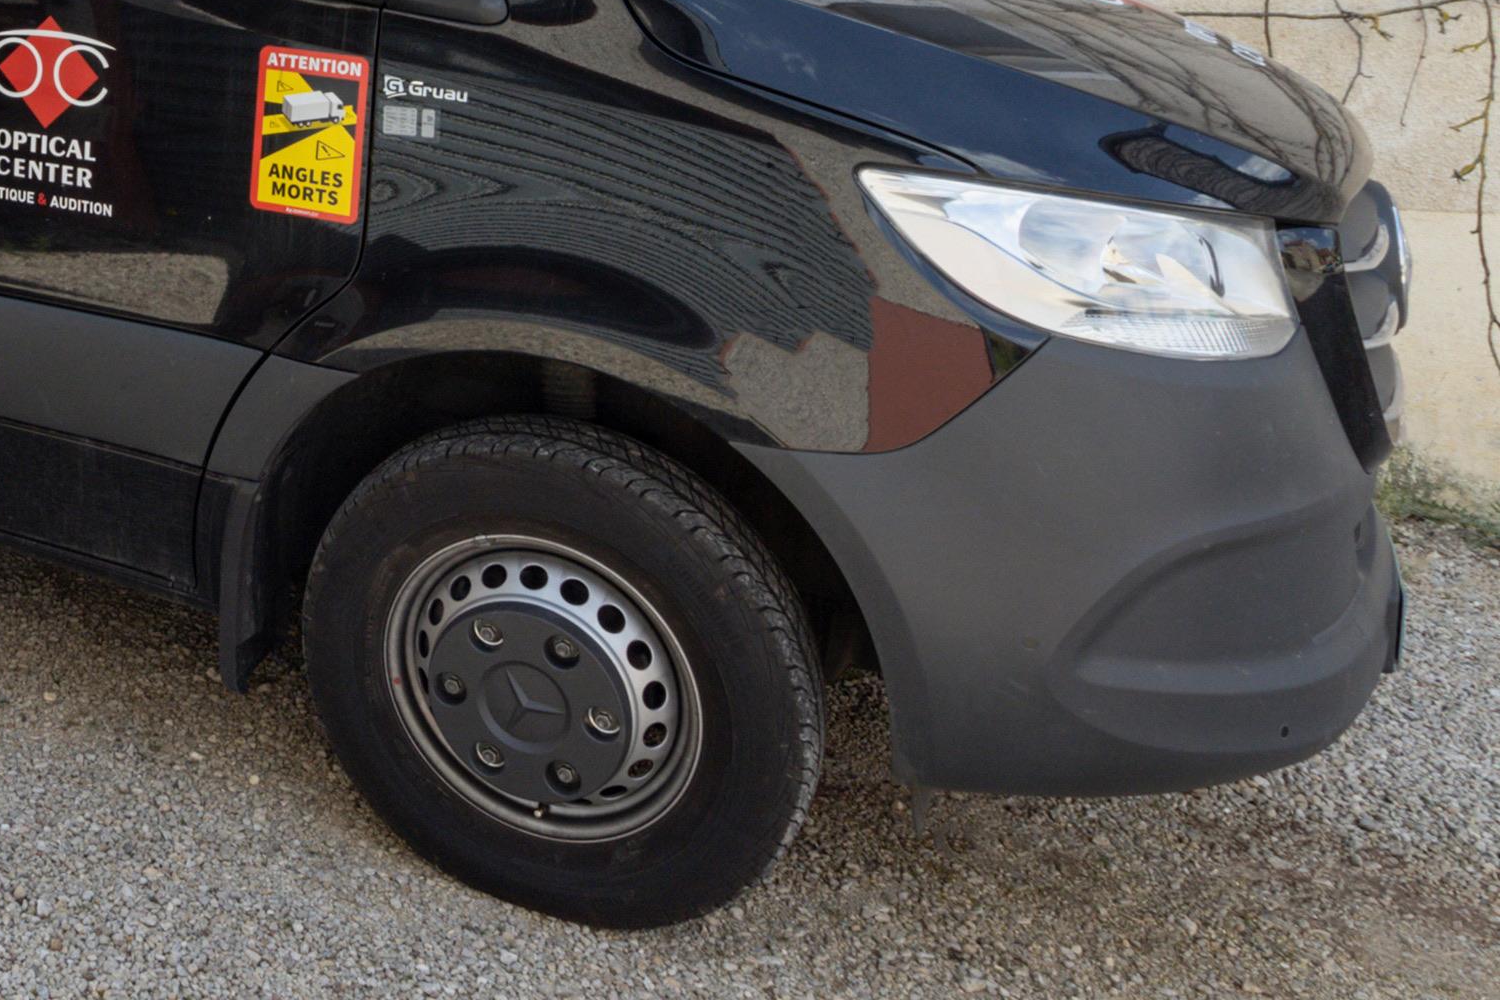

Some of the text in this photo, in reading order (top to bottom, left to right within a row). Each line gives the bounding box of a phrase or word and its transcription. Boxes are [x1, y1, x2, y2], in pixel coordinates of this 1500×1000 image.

[266, 52, 363, 77] ATTENTION
[408, 80, 469, 103] Gruau
[268, 162, 344, 188] ANGLES
[36, 191, 47, 206] &
[49, 194, 113, 218] AUDITION
[271, 181, 339, 206] MORTS
